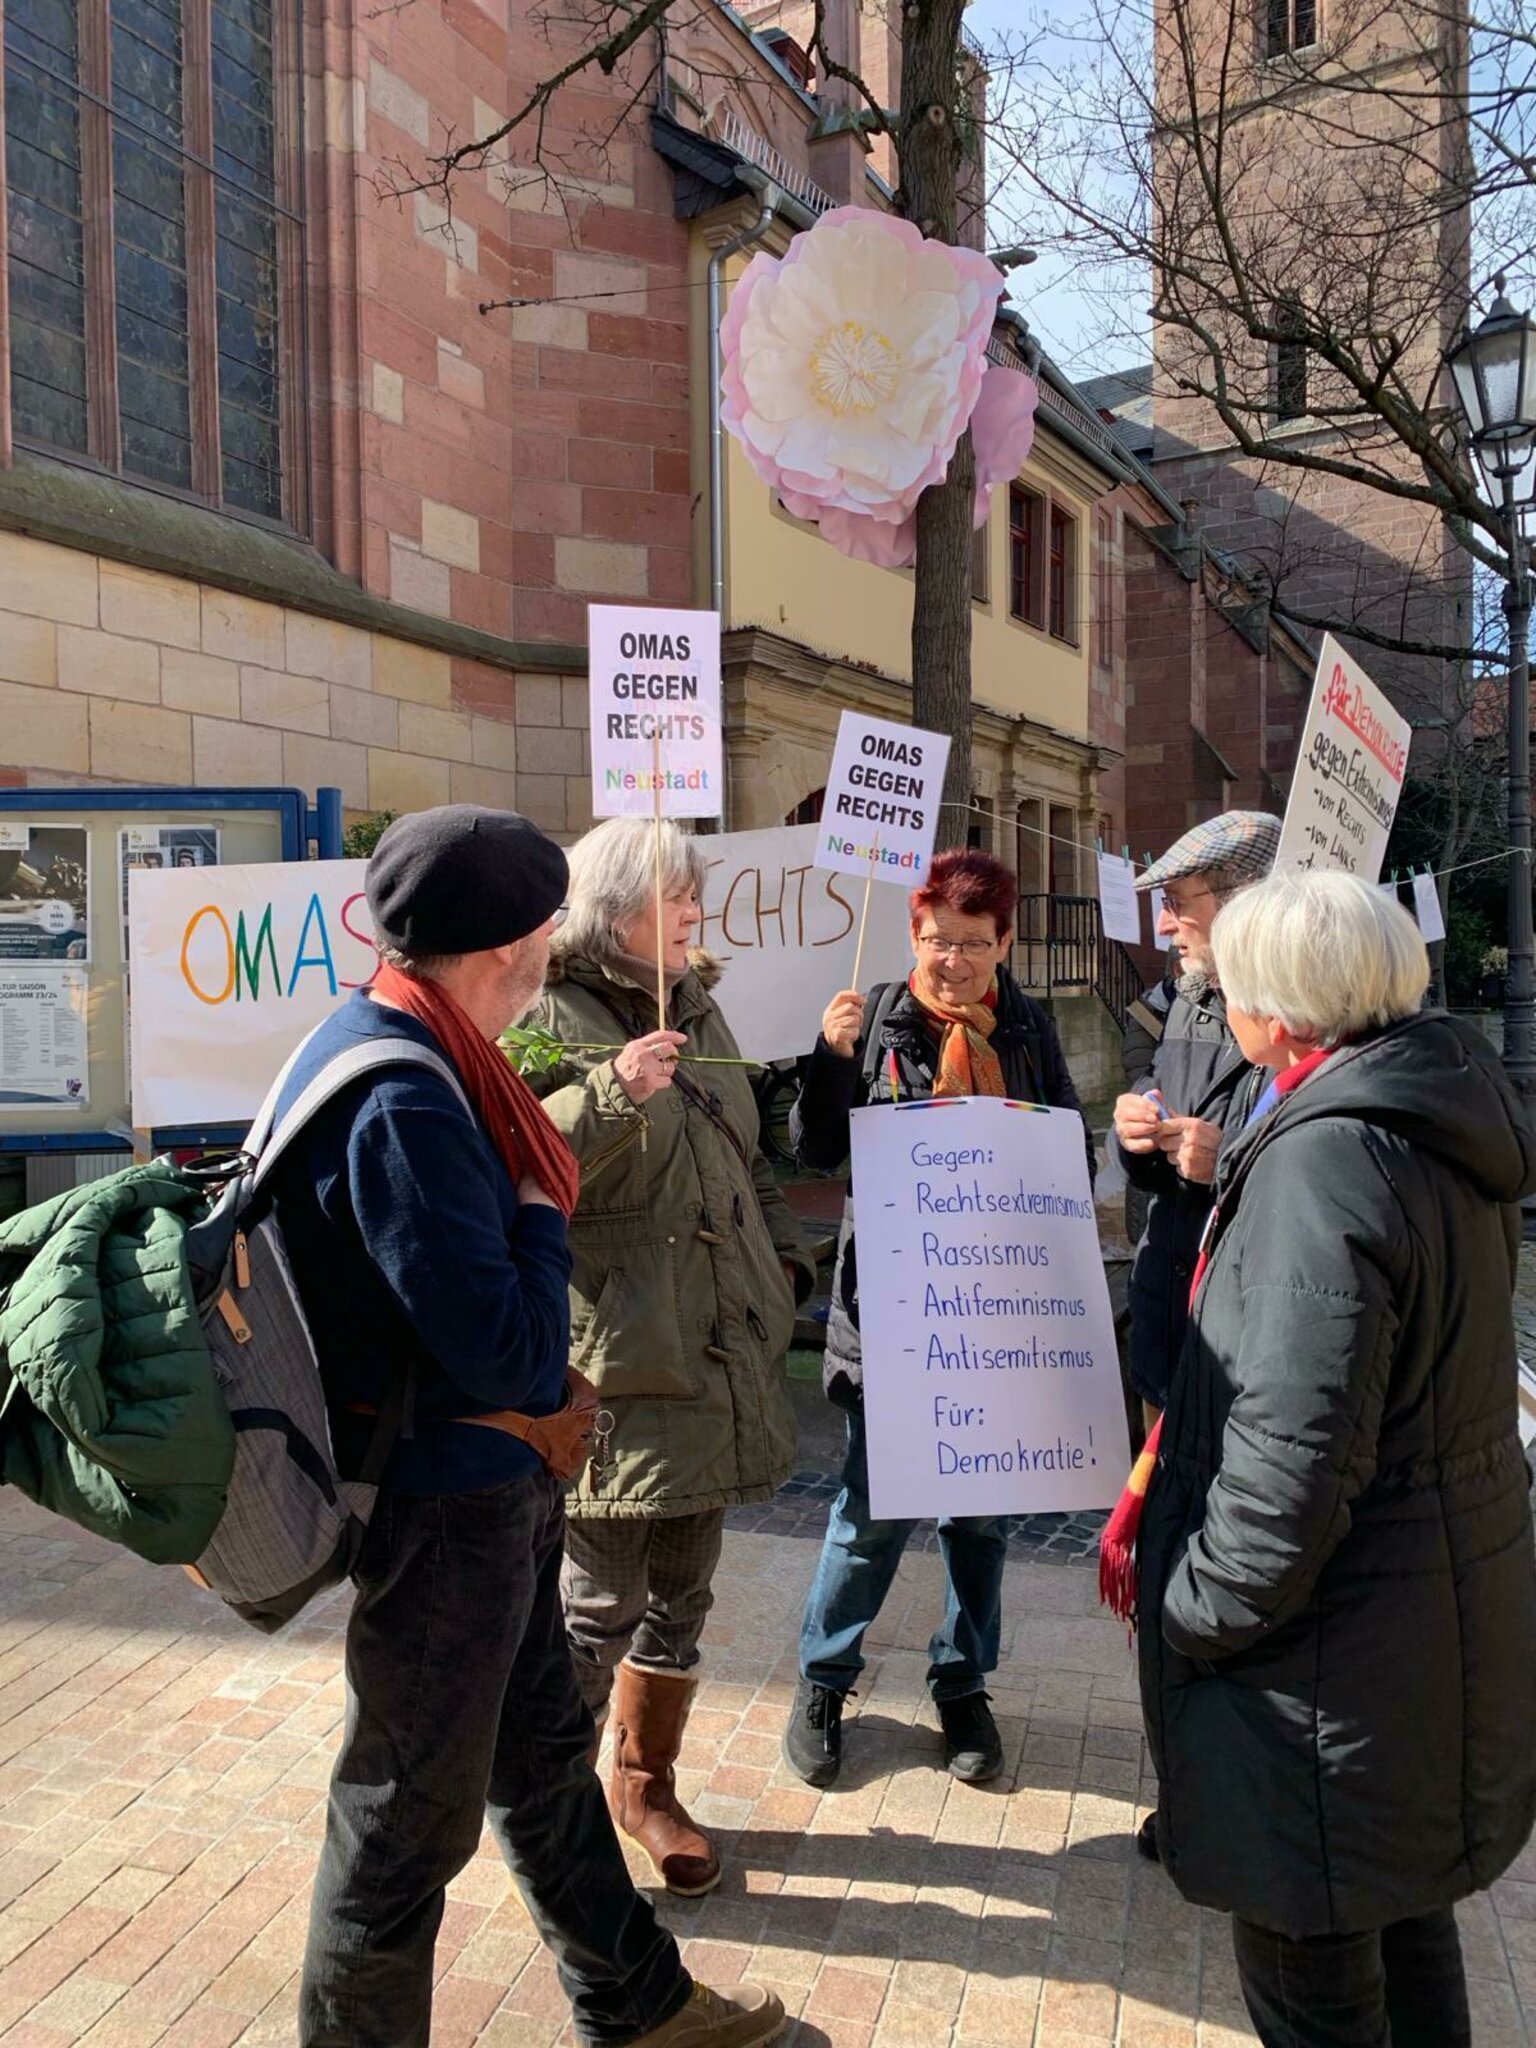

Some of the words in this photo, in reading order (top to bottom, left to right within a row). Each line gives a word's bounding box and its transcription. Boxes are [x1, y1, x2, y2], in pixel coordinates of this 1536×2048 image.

[620, 632, 690, 661] OMAS
[613, 673, 697, 700] GEGEN
[607, 713, 705, 740] RECHTS
[861, 735, 923, 767] OMAS
[605, 768, 709, 790] Neustadt
[848, 764, 924, 799] GEGEN
[836, 793, 925, 830] RECHTS
[827, 835, 921, 870] Neustadt
[180, 892, 382, 1005] OMAS
[911, 1142, 993, 1172] Gegen:
[916, 1178, 1093, 1219] Rechtsextremismus
[922, 1231, 1049, 1267] Rassismus
[924, 1282, 1087, 1318] Antifeminismus
[926, 1333, 1094, 1371] Antisemitismus
[934, 1395, 984, 1427] Für:
[937, 1424, 1097, 1475] Demokratie!
